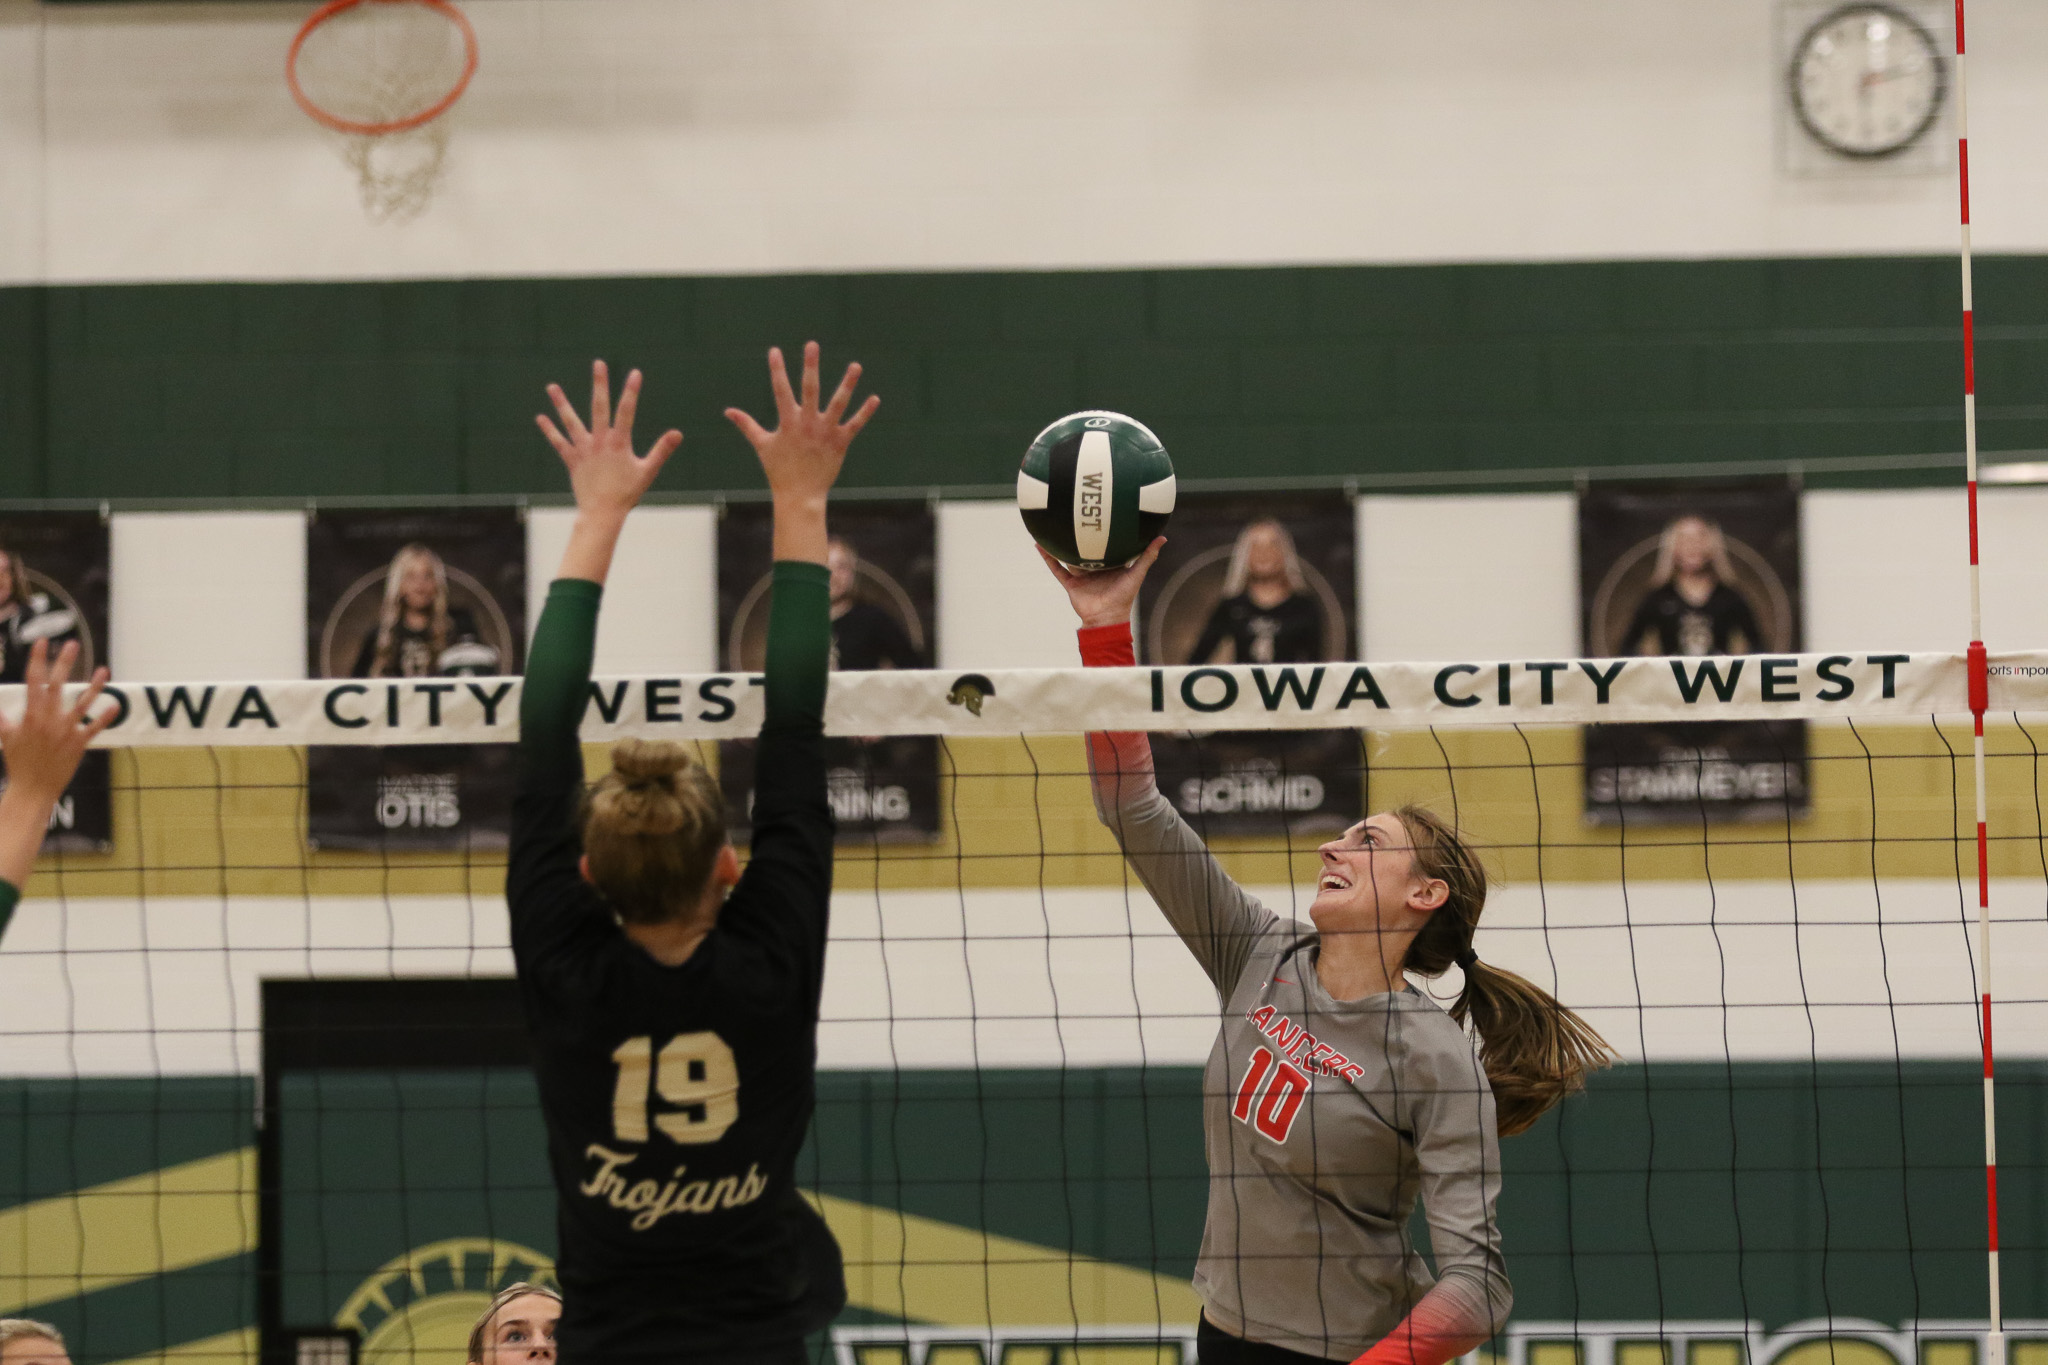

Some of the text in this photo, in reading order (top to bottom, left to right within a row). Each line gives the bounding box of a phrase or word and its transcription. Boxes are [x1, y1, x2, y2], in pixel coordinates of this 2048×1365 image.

[1081, 472, 1103, 531] WEST
[78, 685, 279, 730] OWA
[323, 682, 513, 729] CITY
[1150, 654, 1910, 713] IOWA CITY WEST
[375, 793, 460, 828] OTIS
[611, 1031, 740, 1144] 19
[1232, 1046, 1312, 1145] 10
[580, 1143, 769, 1231] Trojans
